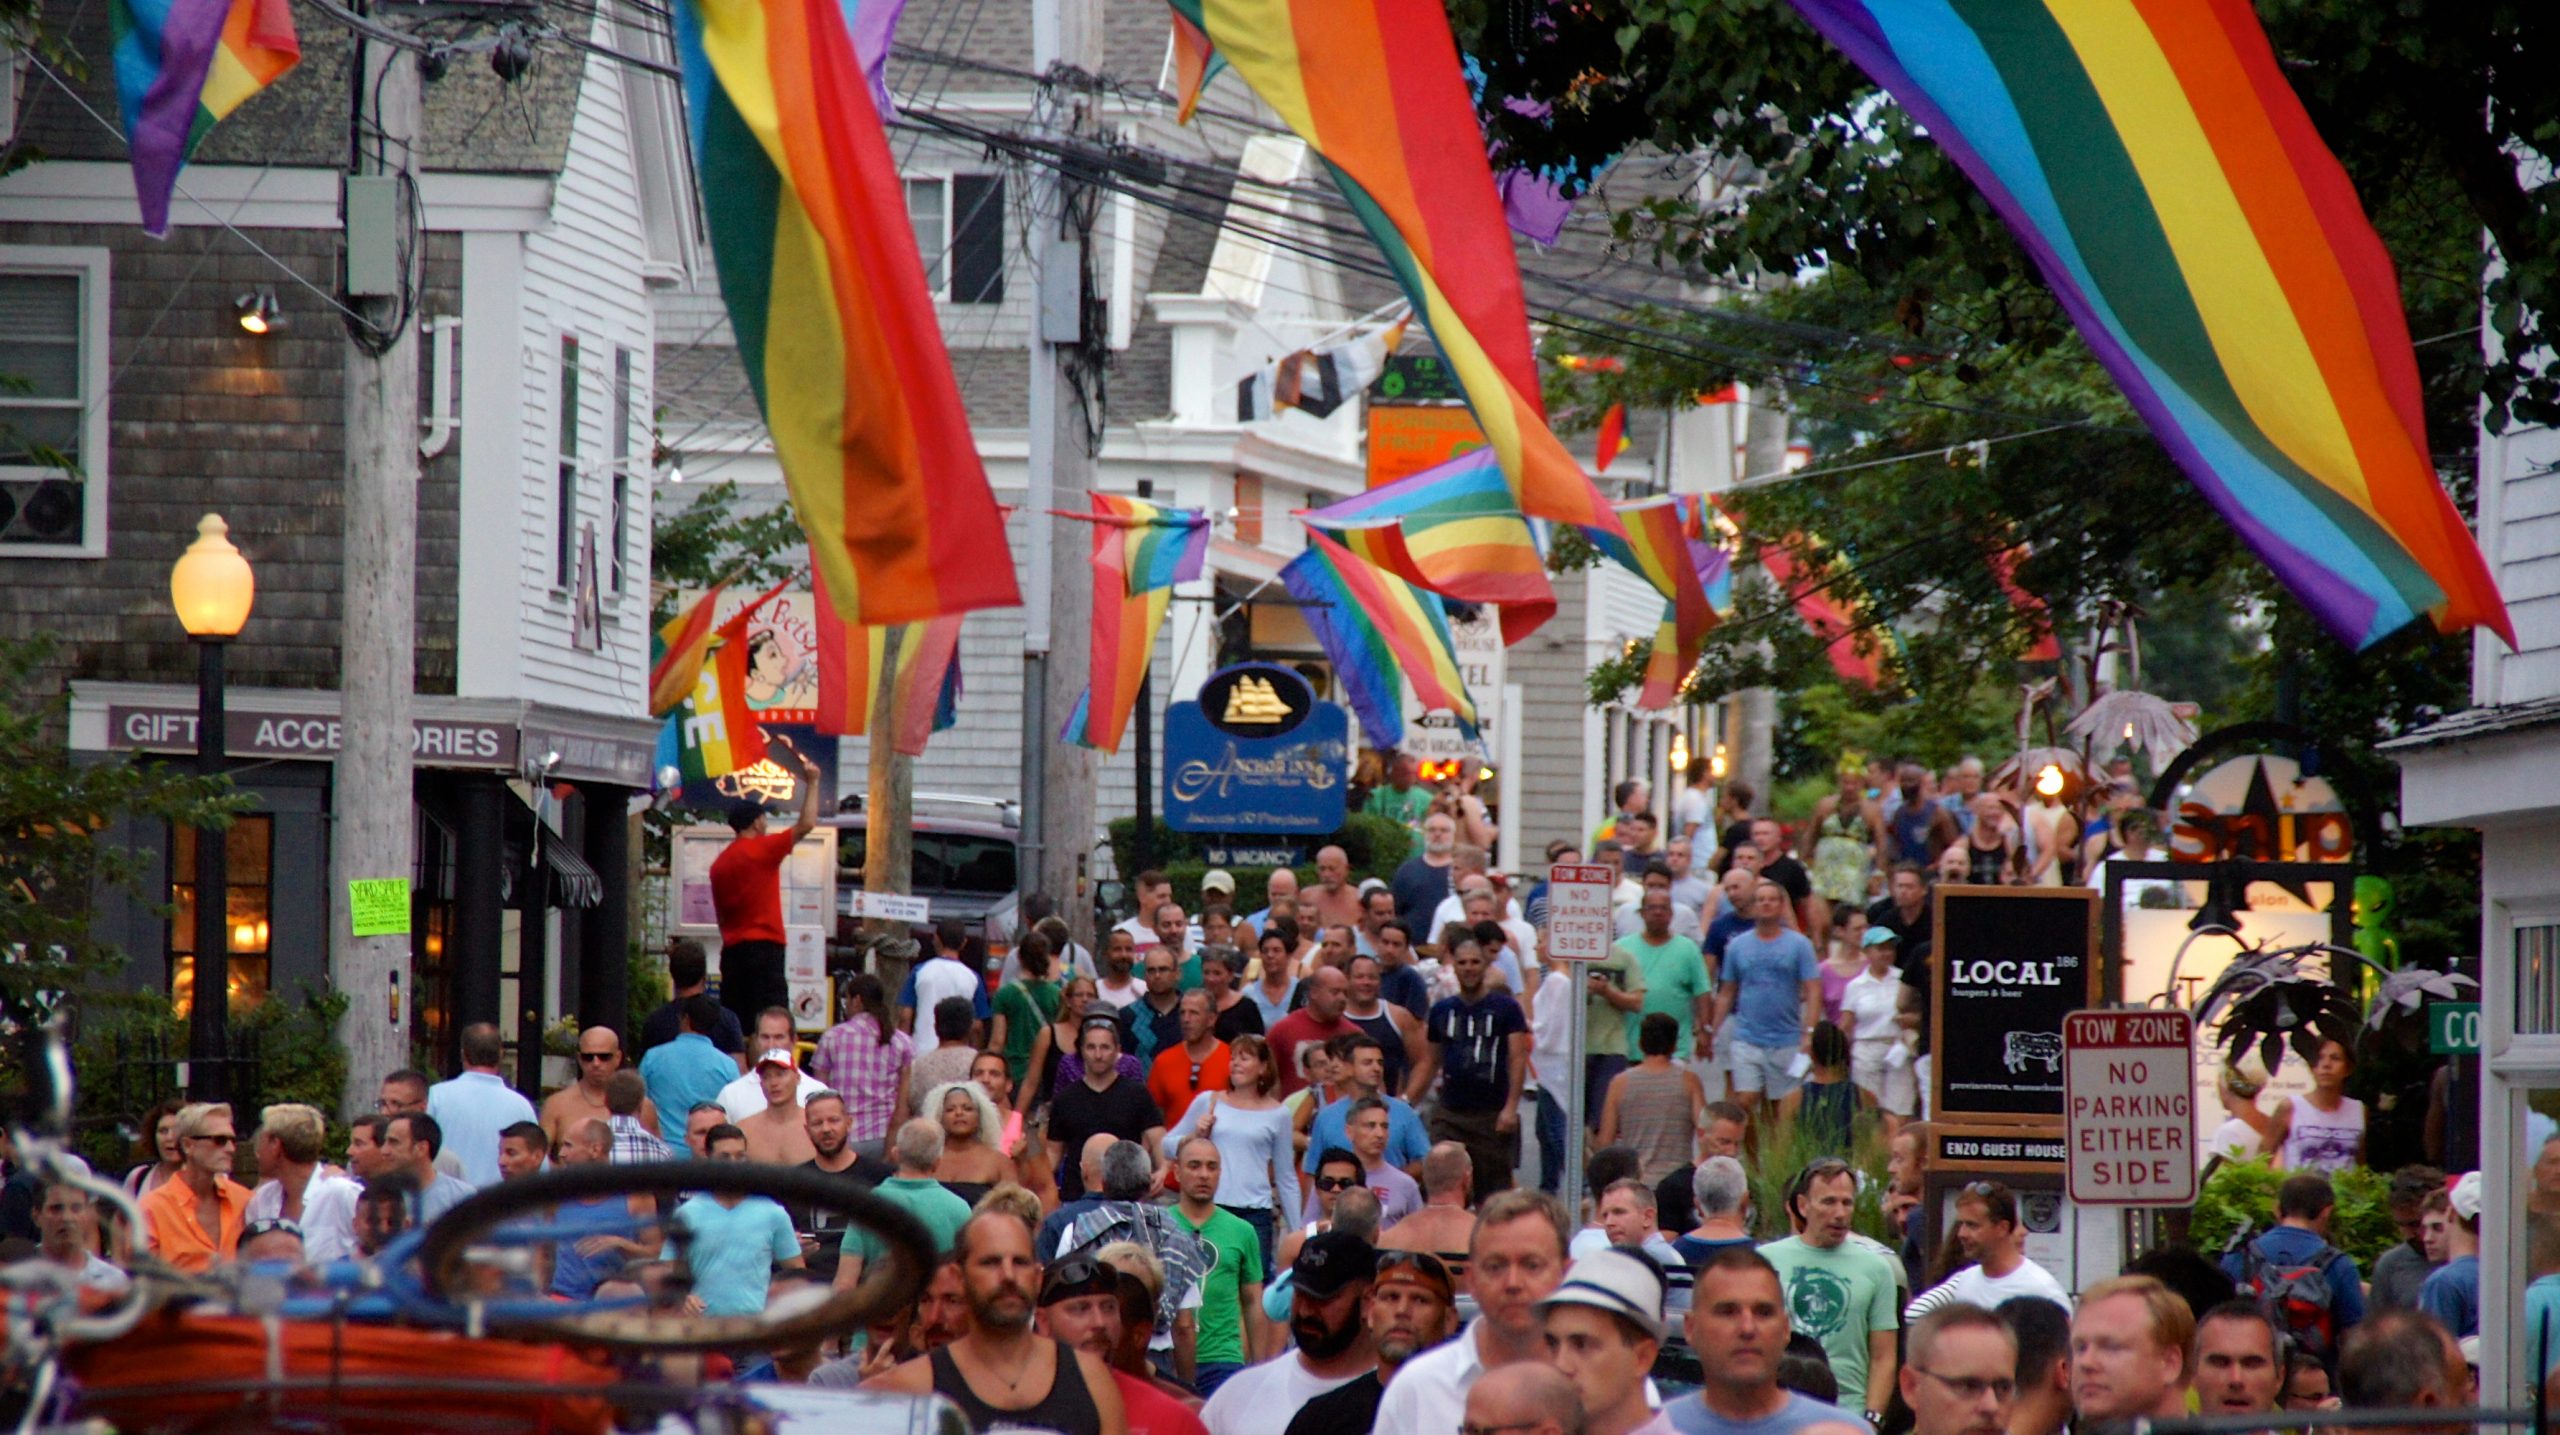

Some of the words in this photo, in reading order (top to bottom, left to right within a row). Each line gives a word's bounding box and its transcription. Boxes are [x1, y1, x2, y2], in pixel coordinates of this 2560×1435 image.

[255, 719, 499, 757] ACCERIES
[1431, 738, 1481, 754] VACANC
[2172, 797, 2353, 863] Snip
[1208, 850, 1227, 864] NO
[1232, 850, 1296, 865] VACANCY
[1553, 868, 1577, 881] TOW
[1580, 868, 1609, 882] ZONE
[1570, 889, 1590, 901] NO
[2250, 892, 2290, 907] alon
[1551, 905, 1609, 918] PARKING
[1554, 921, 1605, 934] EITHER
[1559, 937, 1598, 950] SIDE
[1951, 959, 2061, 986] LOCAL
[2056, 955, 2079, 968] 186
[1951, 987, 1989, 998] burgers
[1990, 988, 1999, 998] &
[2000, 987, 2023, 998] beer
[2073, 1019, 2117, 1044] TOW
[2128, 1017, 2185, 1043] ZONE
[2109, 1061, 2148, 1085] NO
[2074, 1095, 2188, 1119] PARKING
[2080, 1127, 2183, 1152] EITHER
[1946, 1142, 1980, 1156] ENZO
[1981, 1143, 2023, 1157] GUEST
[2025, 1145, 2066, 1159] HOUSE
[2093, 1160, 2171, 1185] SIDE
